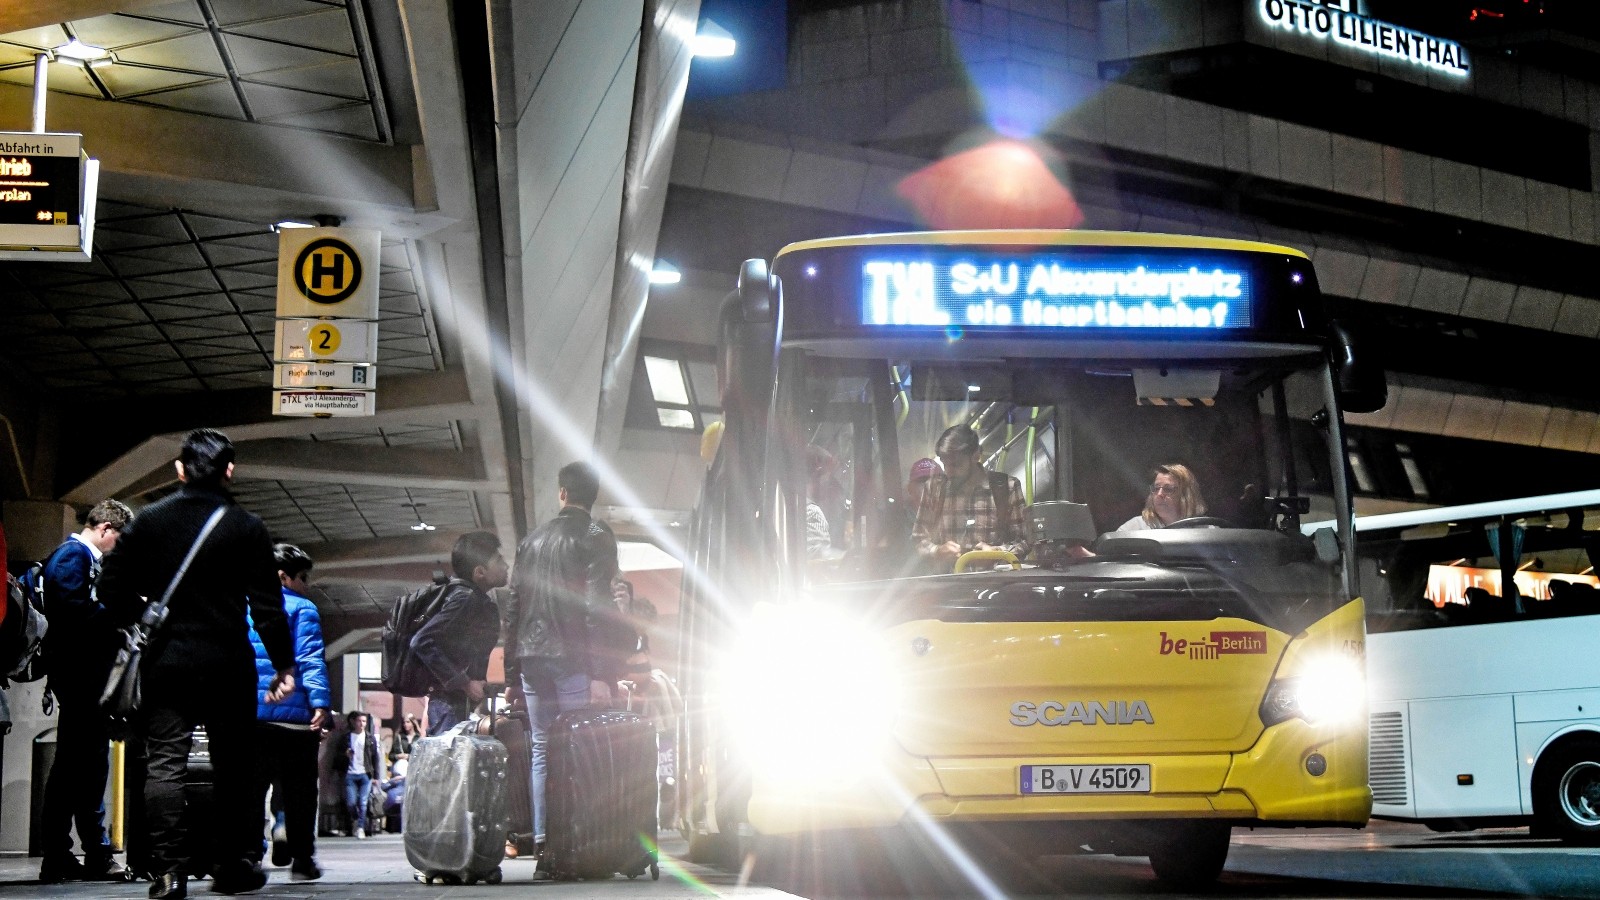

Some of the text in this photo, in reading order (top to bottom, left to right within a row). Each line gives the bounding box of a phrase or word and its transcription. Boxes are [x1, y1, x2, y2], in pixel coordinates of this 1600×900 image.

[1265, 0, 1469, 72] OTTO LILIENTHAL
[0, 142, 54, 154] Abfahrt in
[0, 187, 31, 202] rplan
[312, 253, 344, 289] H
[1027, 263, 1242, 302] Alexanderplatz
[866, 262, 950, 325] TXL
[966, 299, 1228, 328] via Hauptbahnhof
[319, 330, 331, 349] 2
[354, 369, 365, 384] B
[1160, 632, 1262, 655] be Berlin
[1009, 700, 1154, 726] SCANIA
[1042, 769, 1055, 789] B
[1089, 768, 1140, 788] 4509
